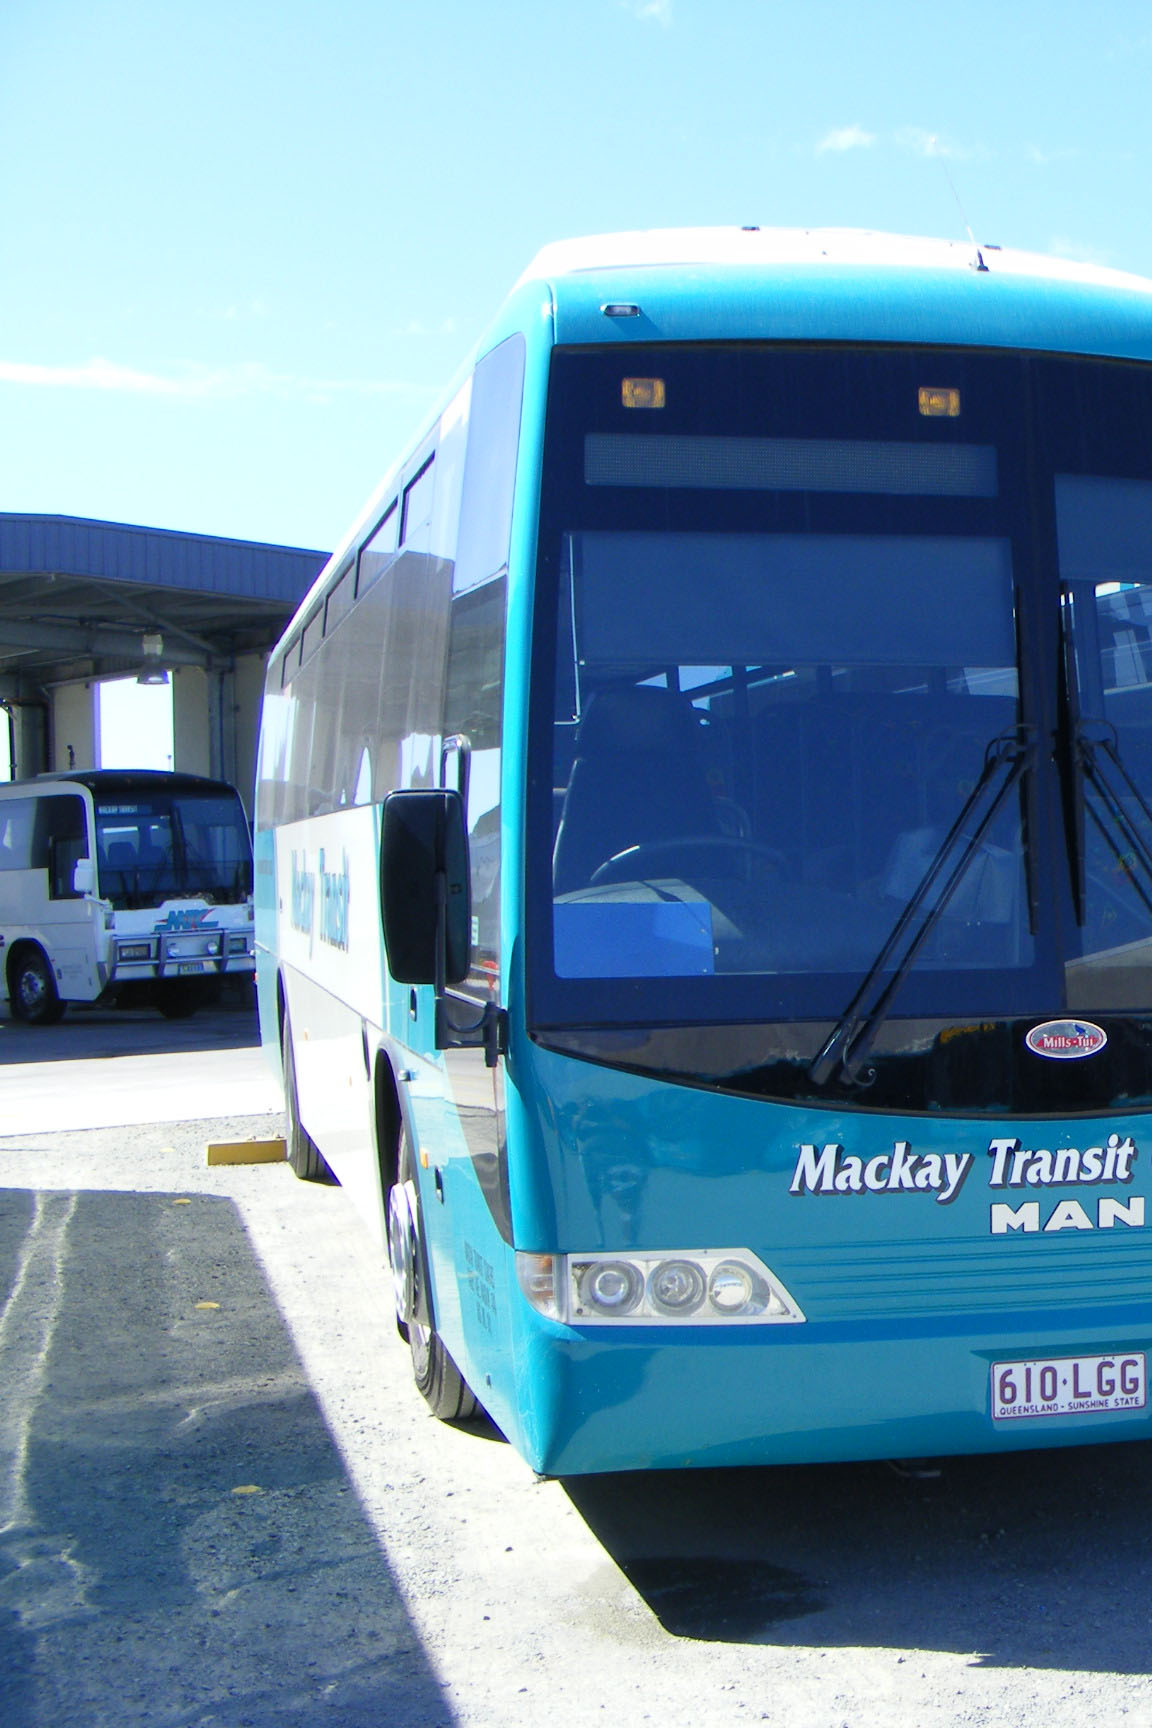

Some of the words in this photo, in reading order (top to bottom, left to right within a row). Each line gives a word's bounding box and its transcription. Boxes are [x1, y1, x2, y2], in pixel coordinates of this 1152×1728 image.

[789, 1141, 975, 1205] Mackay
[986, 1133, 1138, 1190] Transit
[990, 1196, 1145, 1234] MAN
[1000, 1403, 1059, 1416] QUEENSLAND
[1067, 1398, 1109, 1410] SUNSHINE
[1114, 1396, 1140, 1406] STATE
